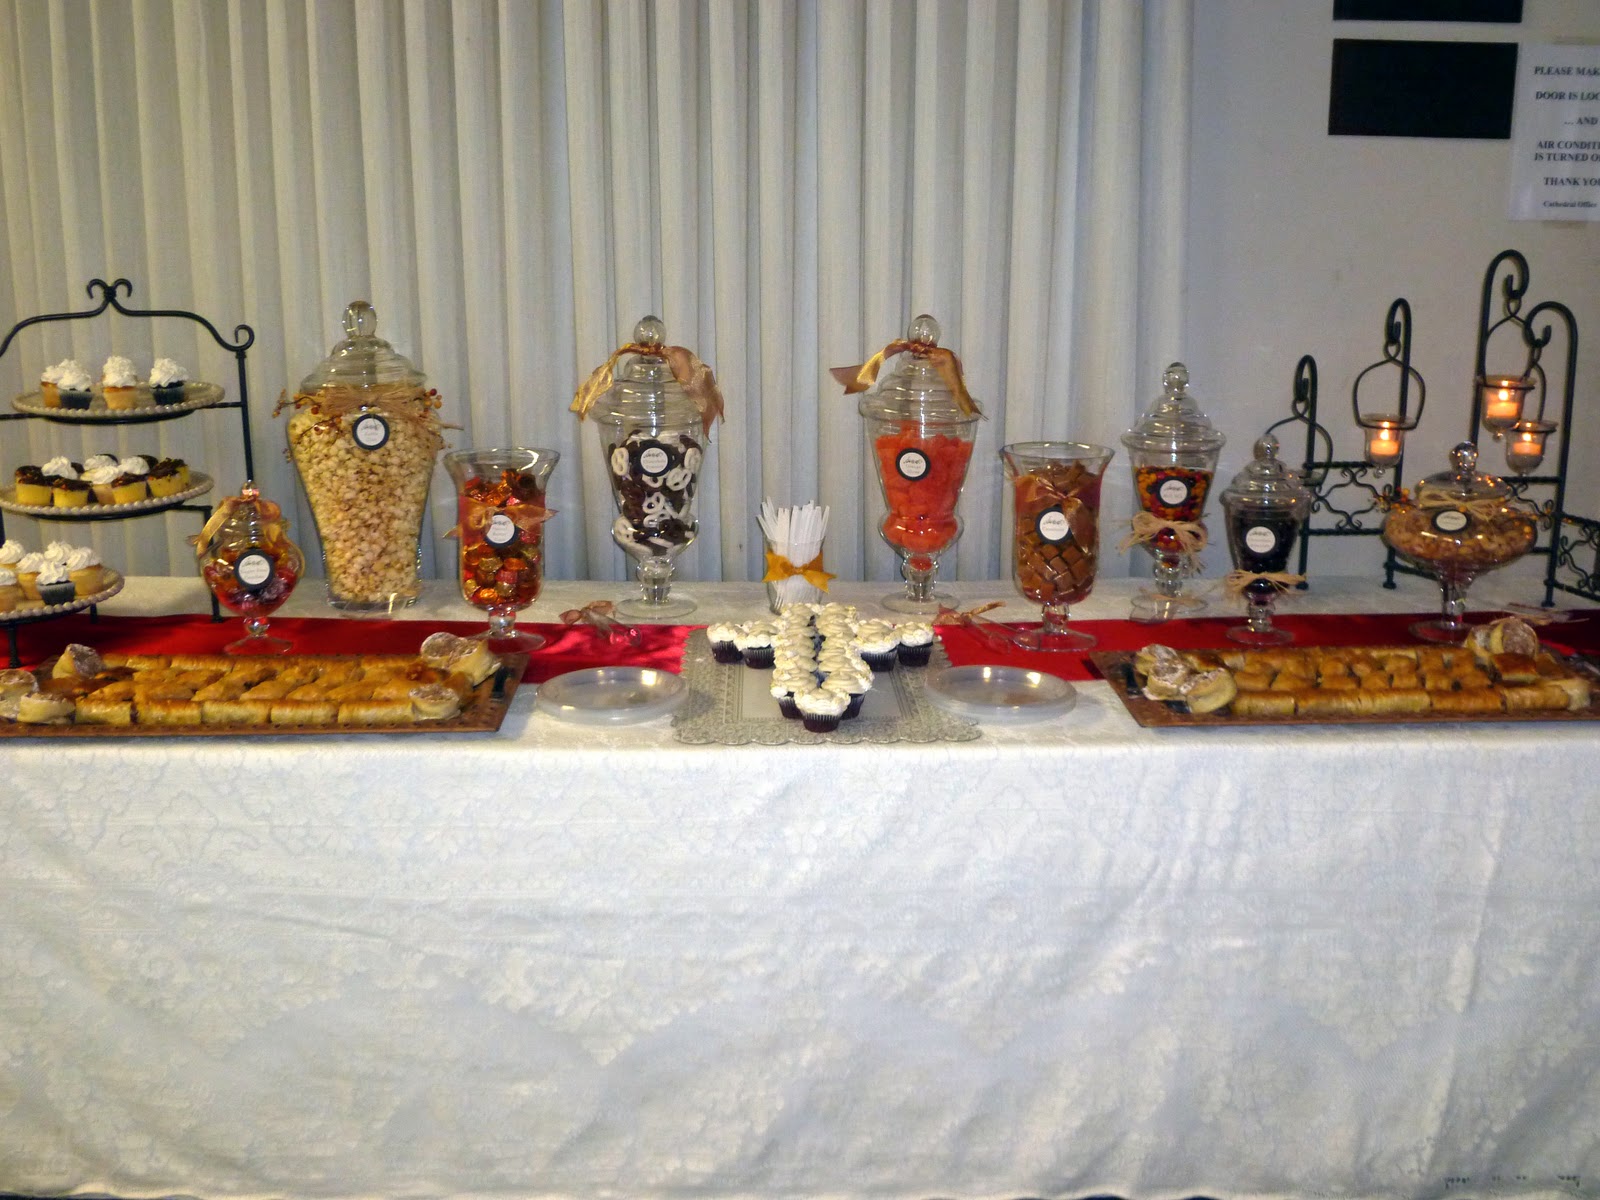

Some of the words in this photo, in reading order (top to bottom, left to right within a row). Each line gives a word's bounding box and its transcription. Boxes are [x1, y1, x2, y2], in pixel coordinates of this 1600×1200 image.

[1534, 66, 1573, 75] PLEASE
[1535, 91, 1566, 100] DOOR
[1568, 91, 1578, 100] IS
[1576, 116, 1599, 125] AND
[1536, 141, 1555, 149] AIR
[1534, 153, 1544, 161] IS
[1546, 153, 1589, 161] TURNED
[1543, 177, 1580, 186] THANK
